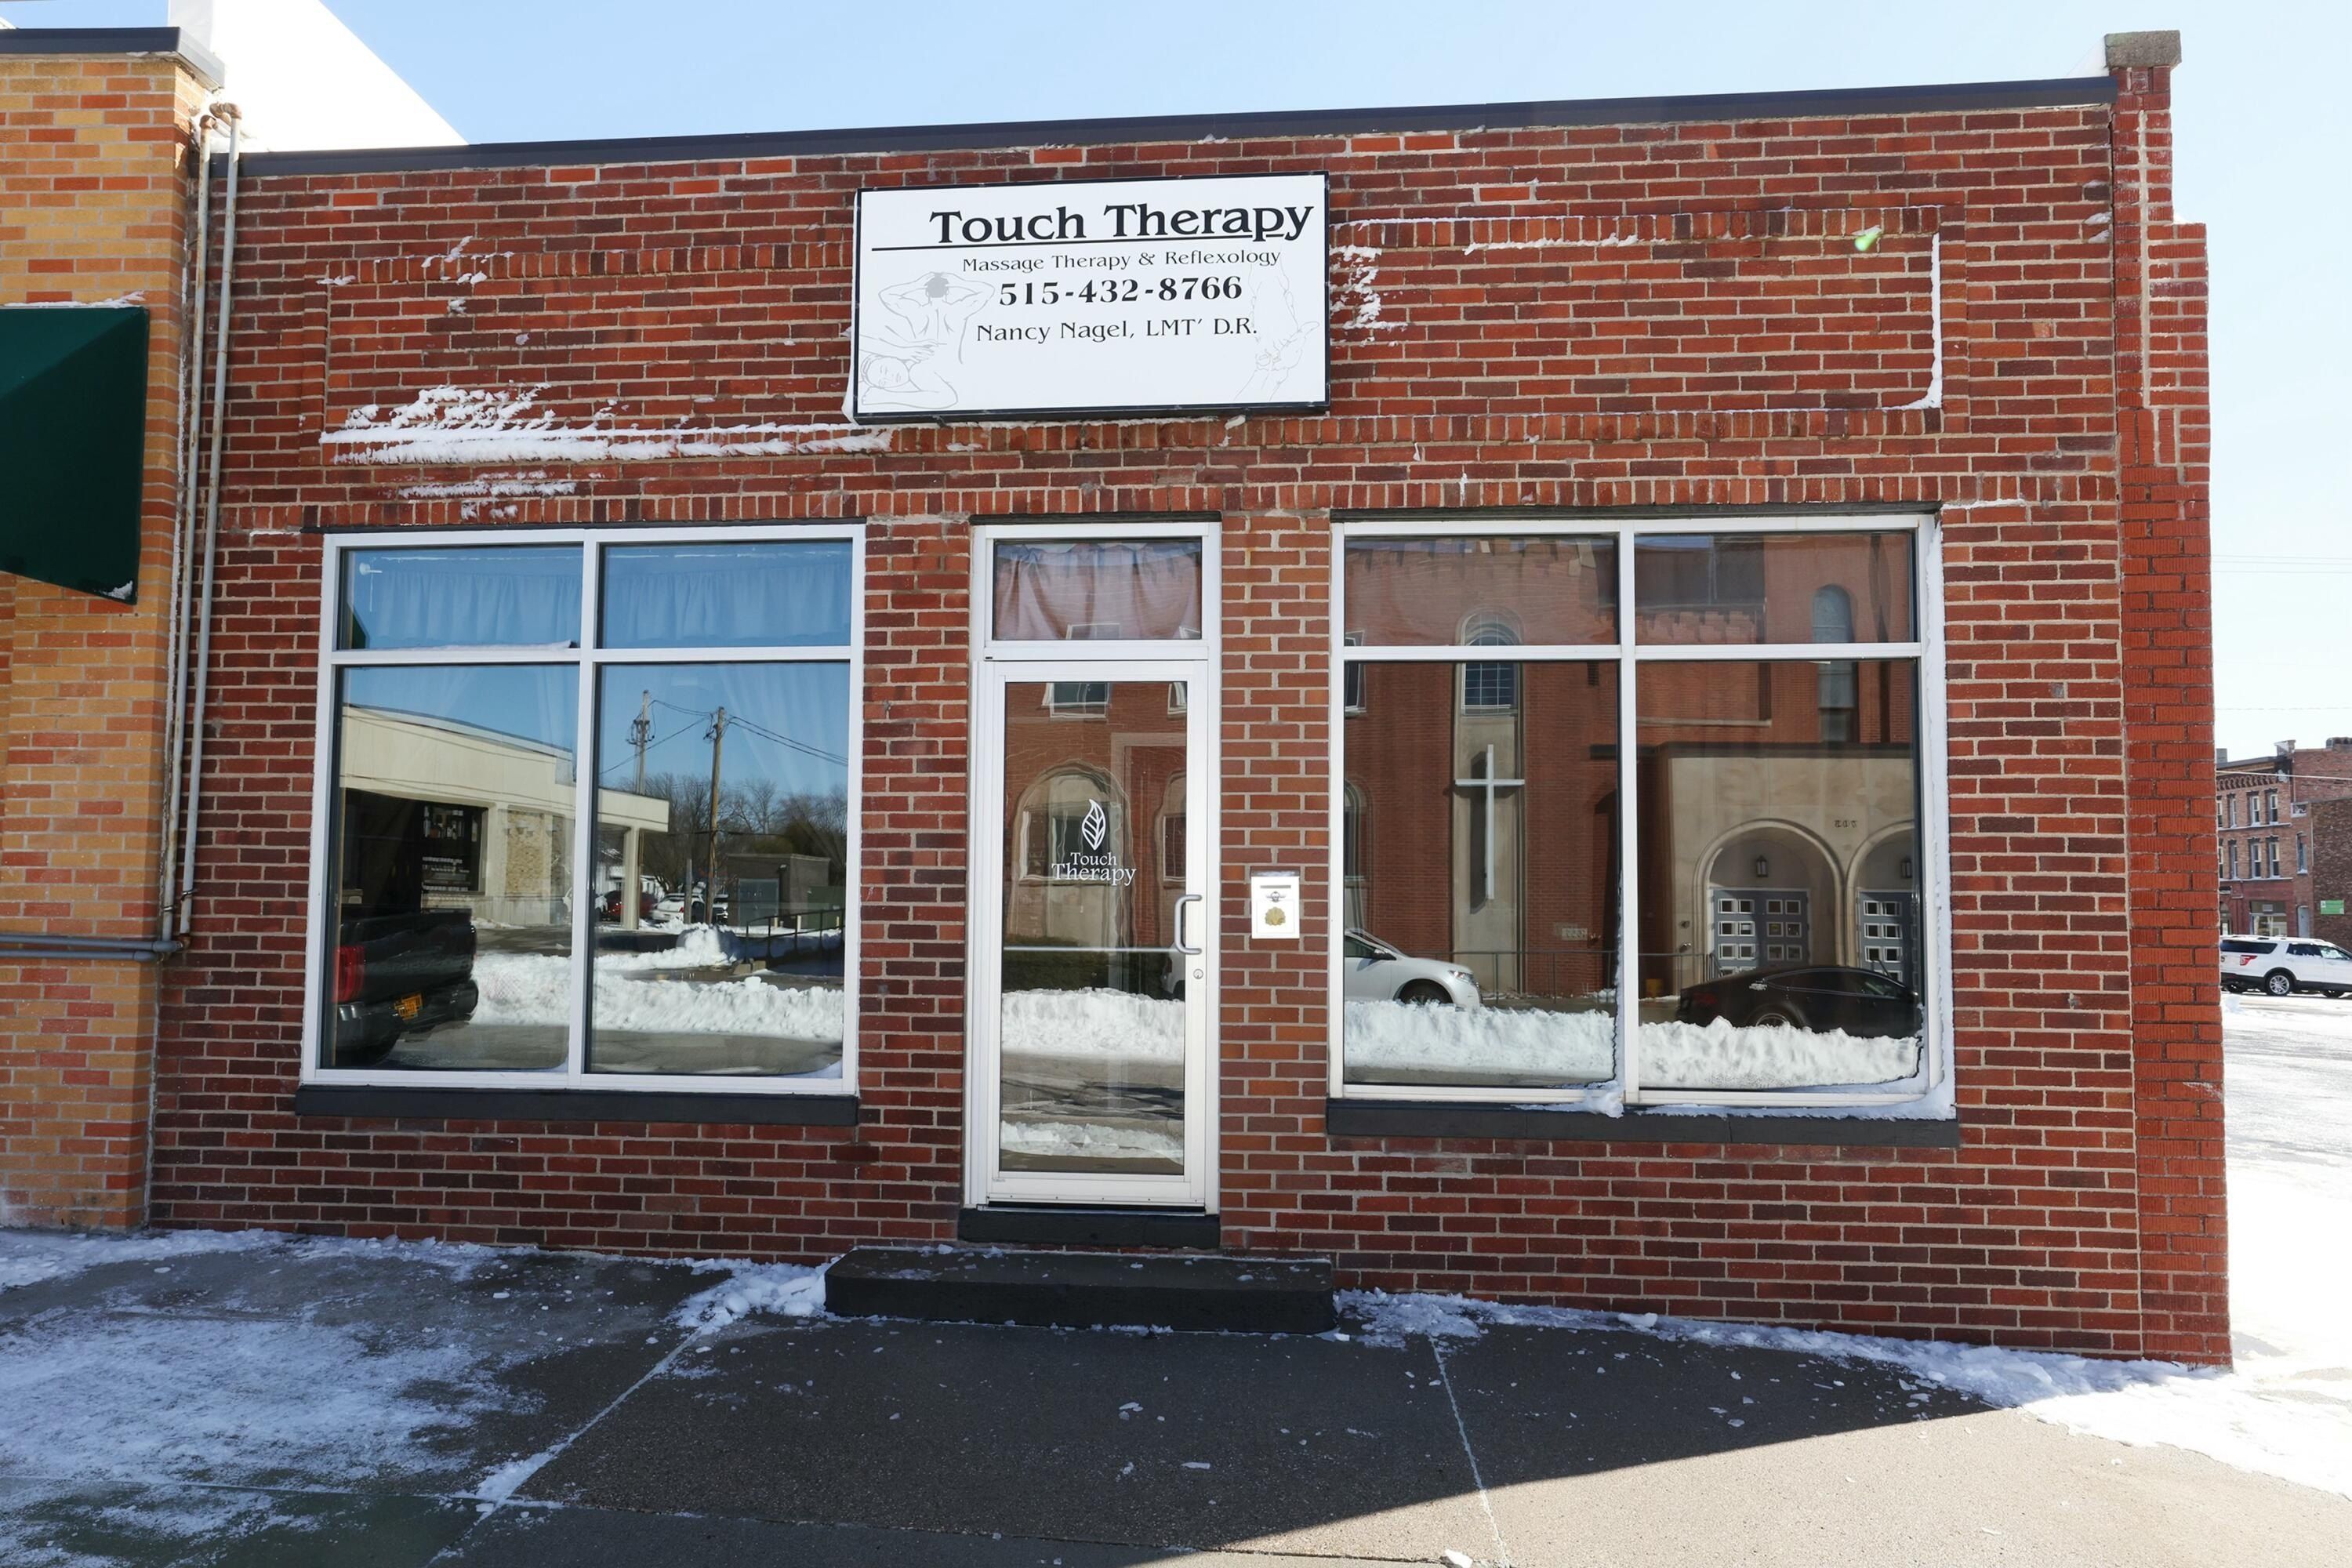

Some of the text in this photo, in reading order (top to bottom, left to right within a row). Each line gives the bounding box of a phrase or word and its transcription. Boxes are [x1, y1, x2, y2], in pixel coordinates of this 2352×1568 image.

[929, 202, 1315, 244] Touch Therapy
[963, 249, 1281, 273] Massage Therapy & Reflexology
[999, 276, 1243, 307] 515-432-8766
[977, 322, 1051, 345] Nancy
[1060, 320, 1134, 343] Nagel,
[1214, 317, 1258, 336] D.R.
[1069, 851, 1118, 866] Touch
[1051, 862, 1137, 887] Therapy
